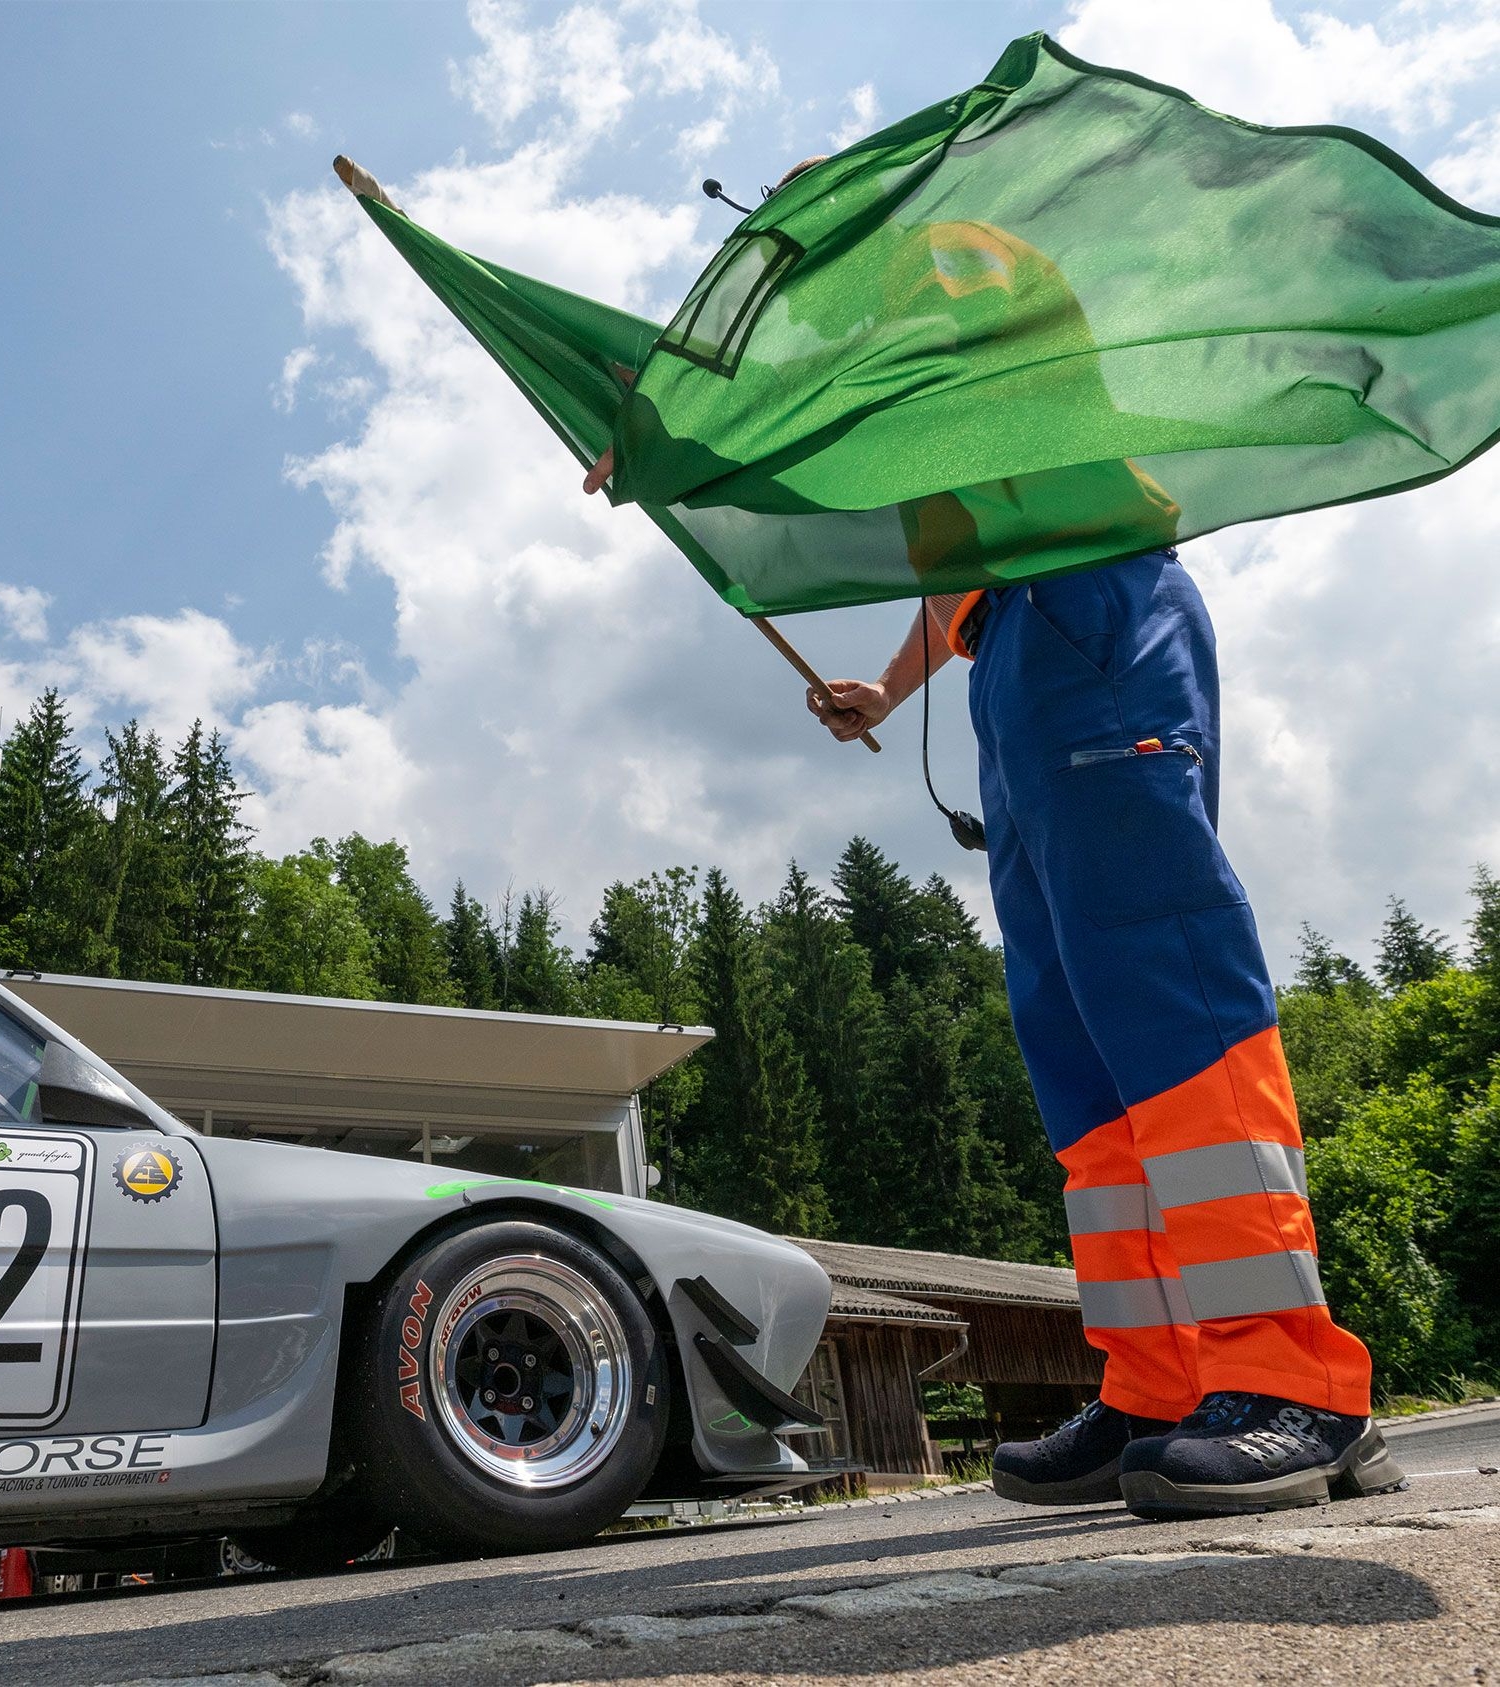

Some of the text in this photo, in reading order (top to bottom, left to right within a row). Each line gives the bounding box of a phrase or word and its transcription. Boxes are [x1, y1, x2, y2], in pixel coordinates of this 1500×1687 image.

[398, 1279, 434, 1422] AVON
[35, 1477, 44, 1491] &
[47, 1475, 89, 1489] TUNING
[92, 1471, 157, 1487] EQUIPMENT
